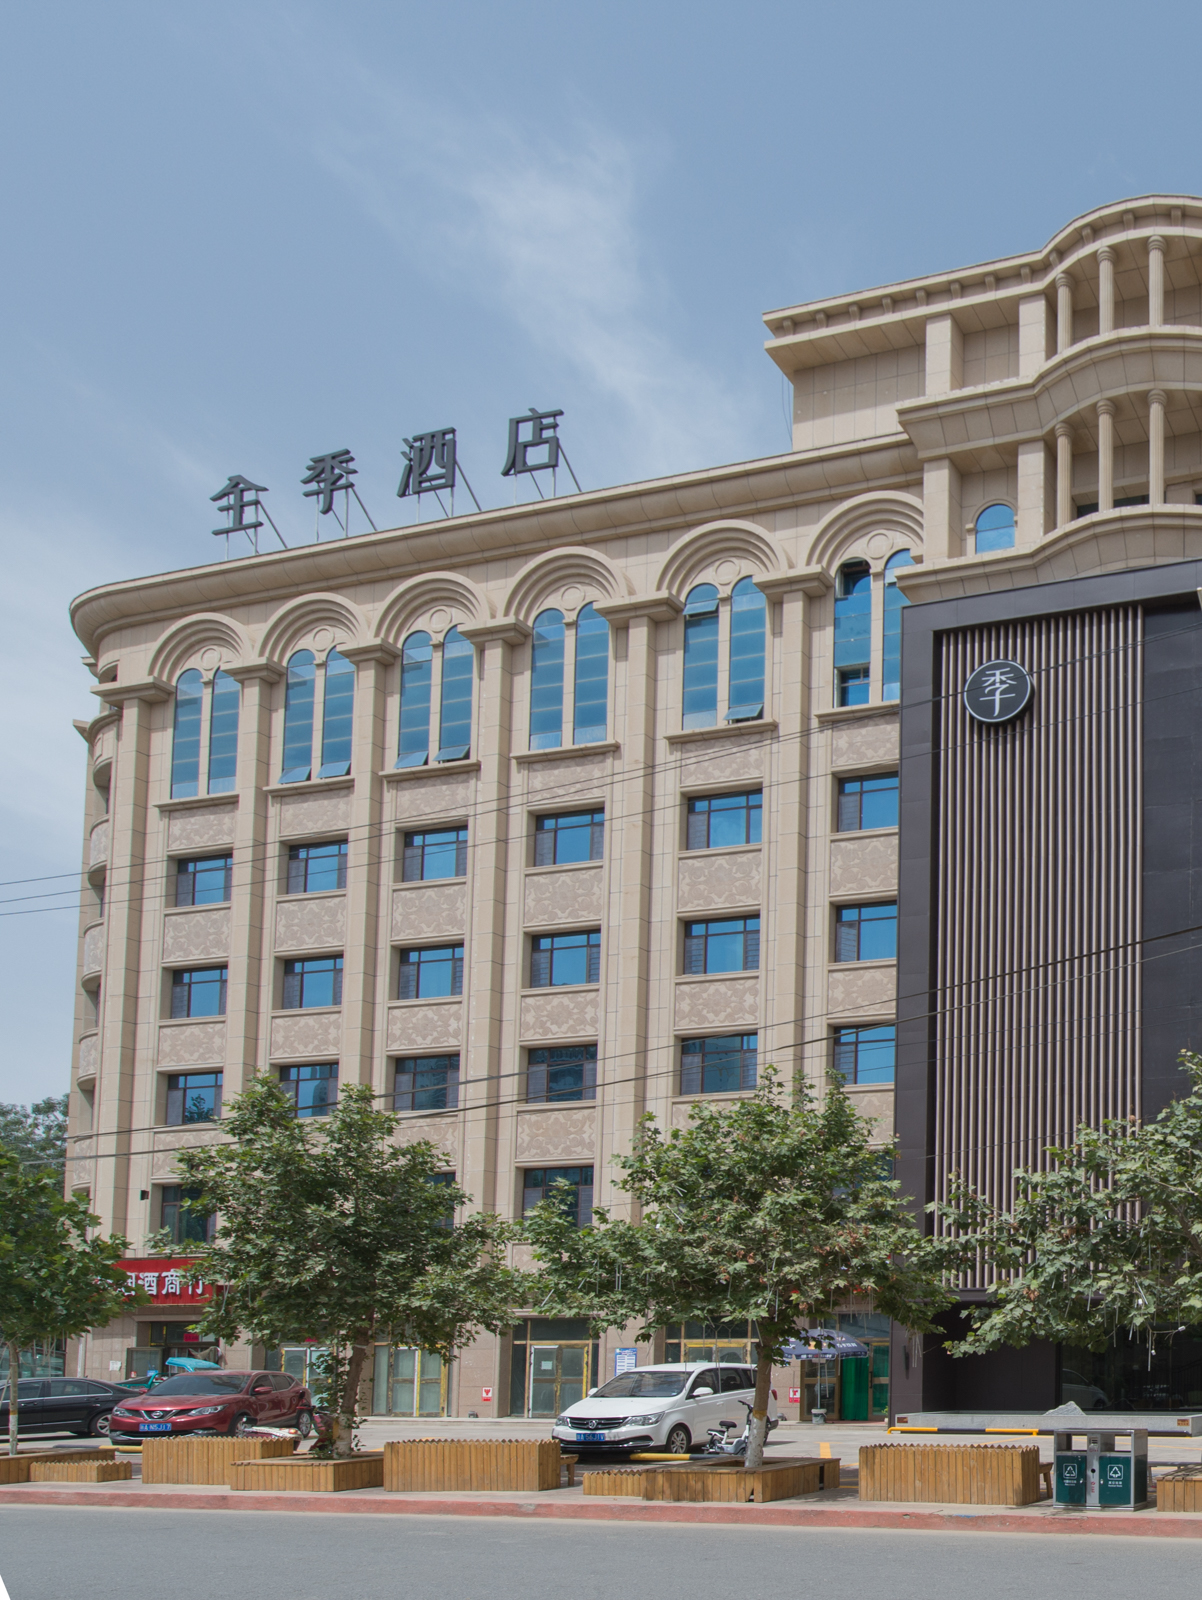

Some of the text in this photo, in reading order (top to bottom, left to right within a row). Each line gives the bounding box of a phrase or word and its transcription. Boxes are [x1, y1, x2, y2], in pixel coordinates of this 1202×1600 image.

[209, 408, 564, 536] 全季酒店
[979, 668, 1016, 718] 季
